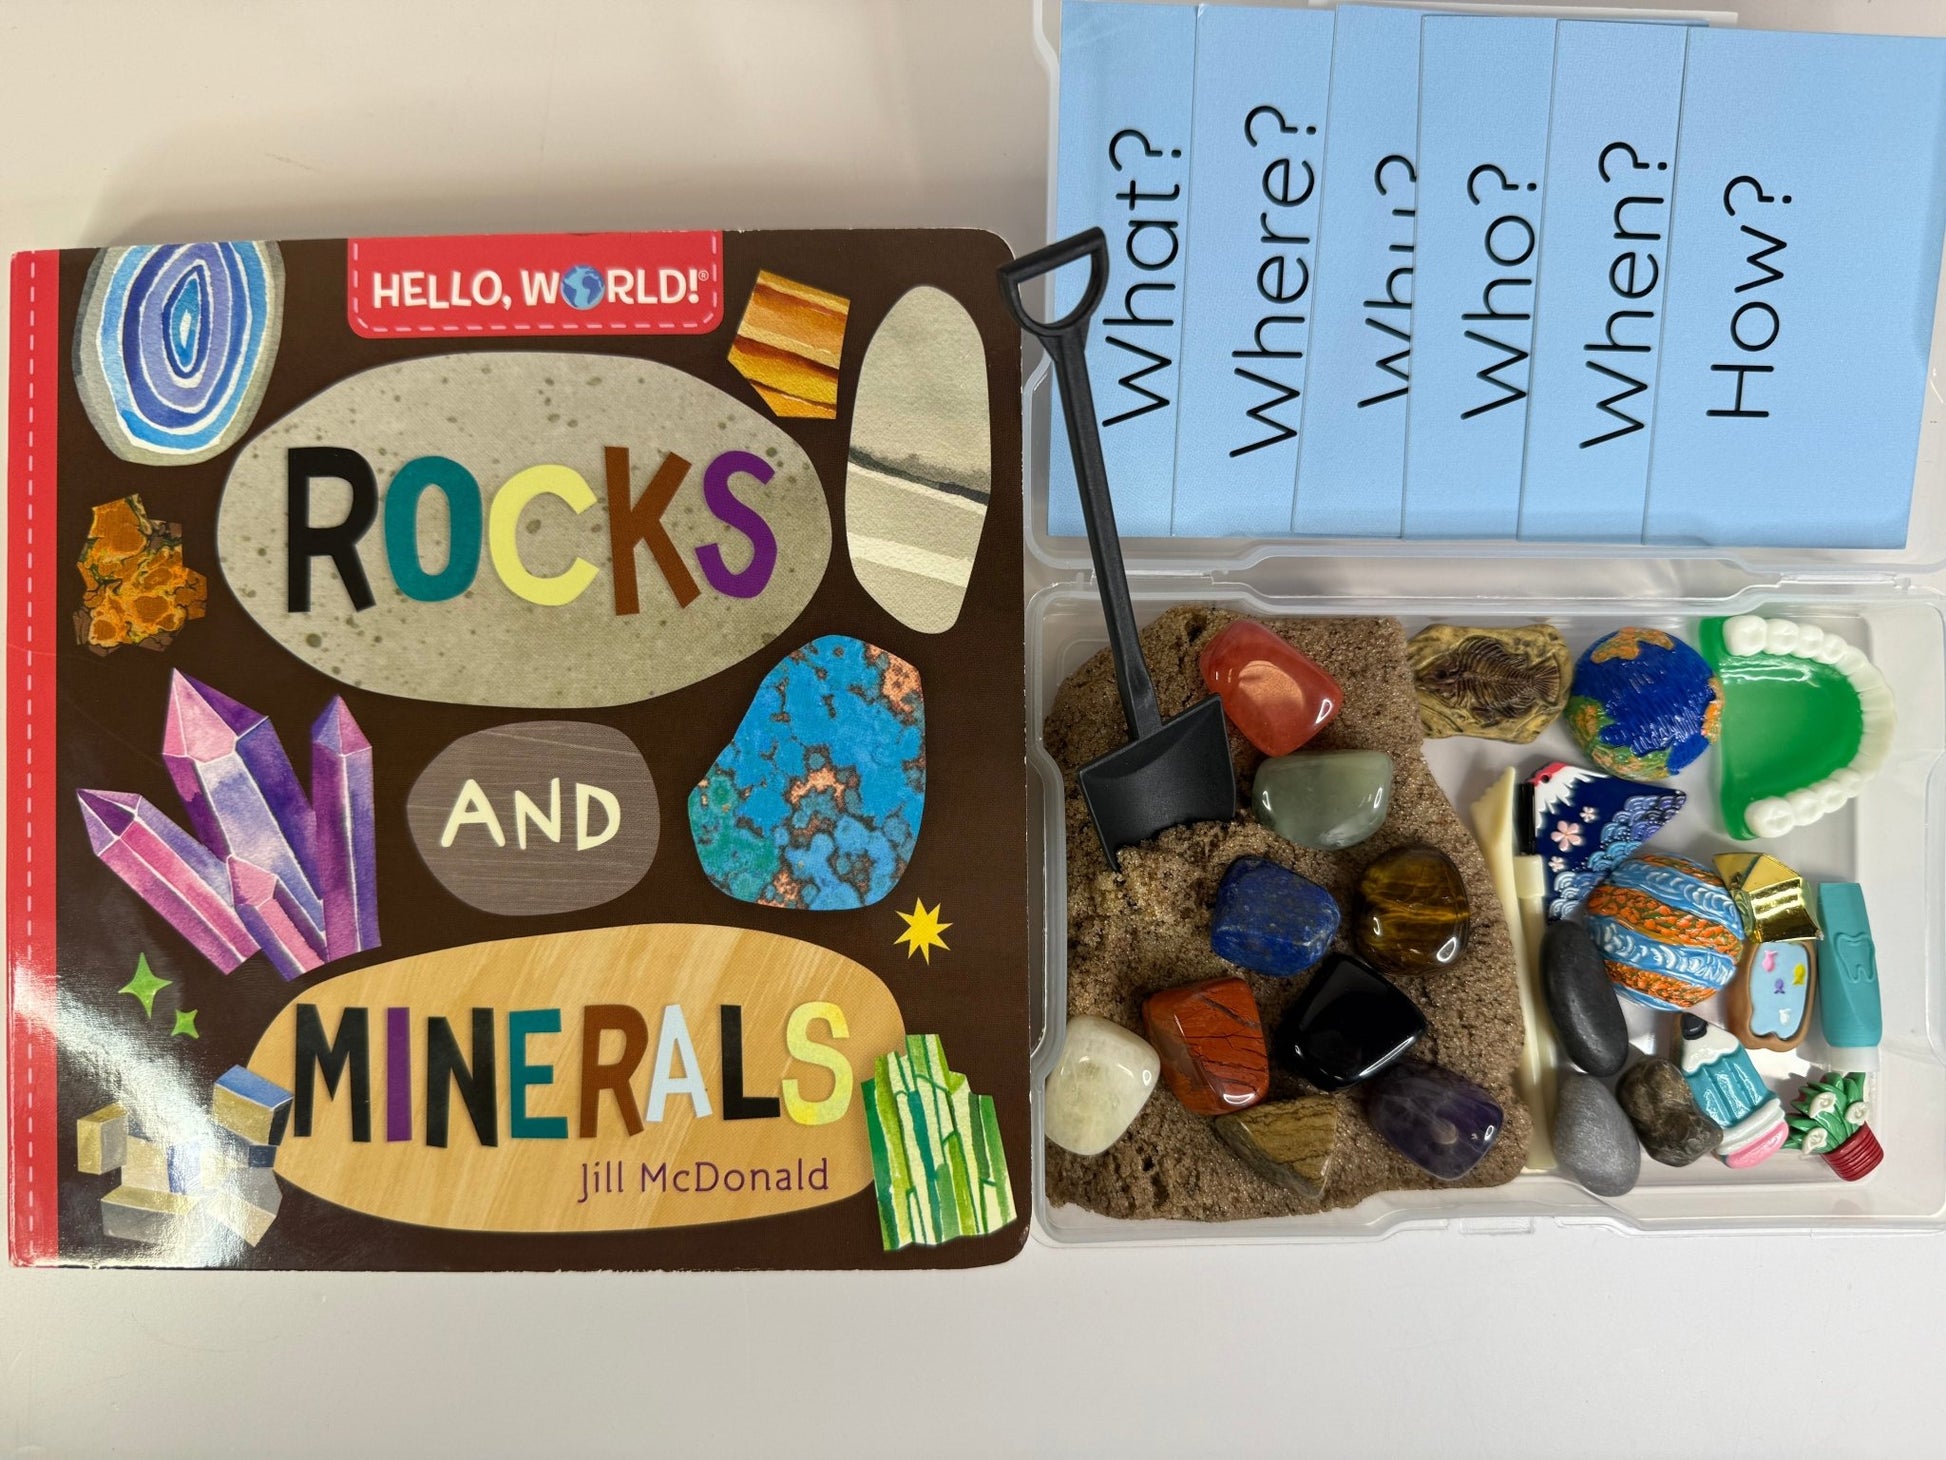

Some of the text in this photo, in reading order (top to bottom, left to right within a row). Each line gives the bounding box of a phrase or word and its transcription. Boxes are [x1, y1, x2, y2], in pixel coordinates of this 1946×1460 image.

[373, 270, 512, 310] HELLO,
[1102, 129, 1182, 428] What?
[1229, 105, 1317, 458] Where?
[1461, 163, 1537, 420] Who?
[1579, 141, 1668, 449] When?
[1706, 175, 1792, 418] How?
[287, 445, 778, 616] ROCKS
[440, 777, 621, 851] AND
[292, 999, 854, 1149] MINERALS
[577, 1157, 830, 1204] Jill McDonald
